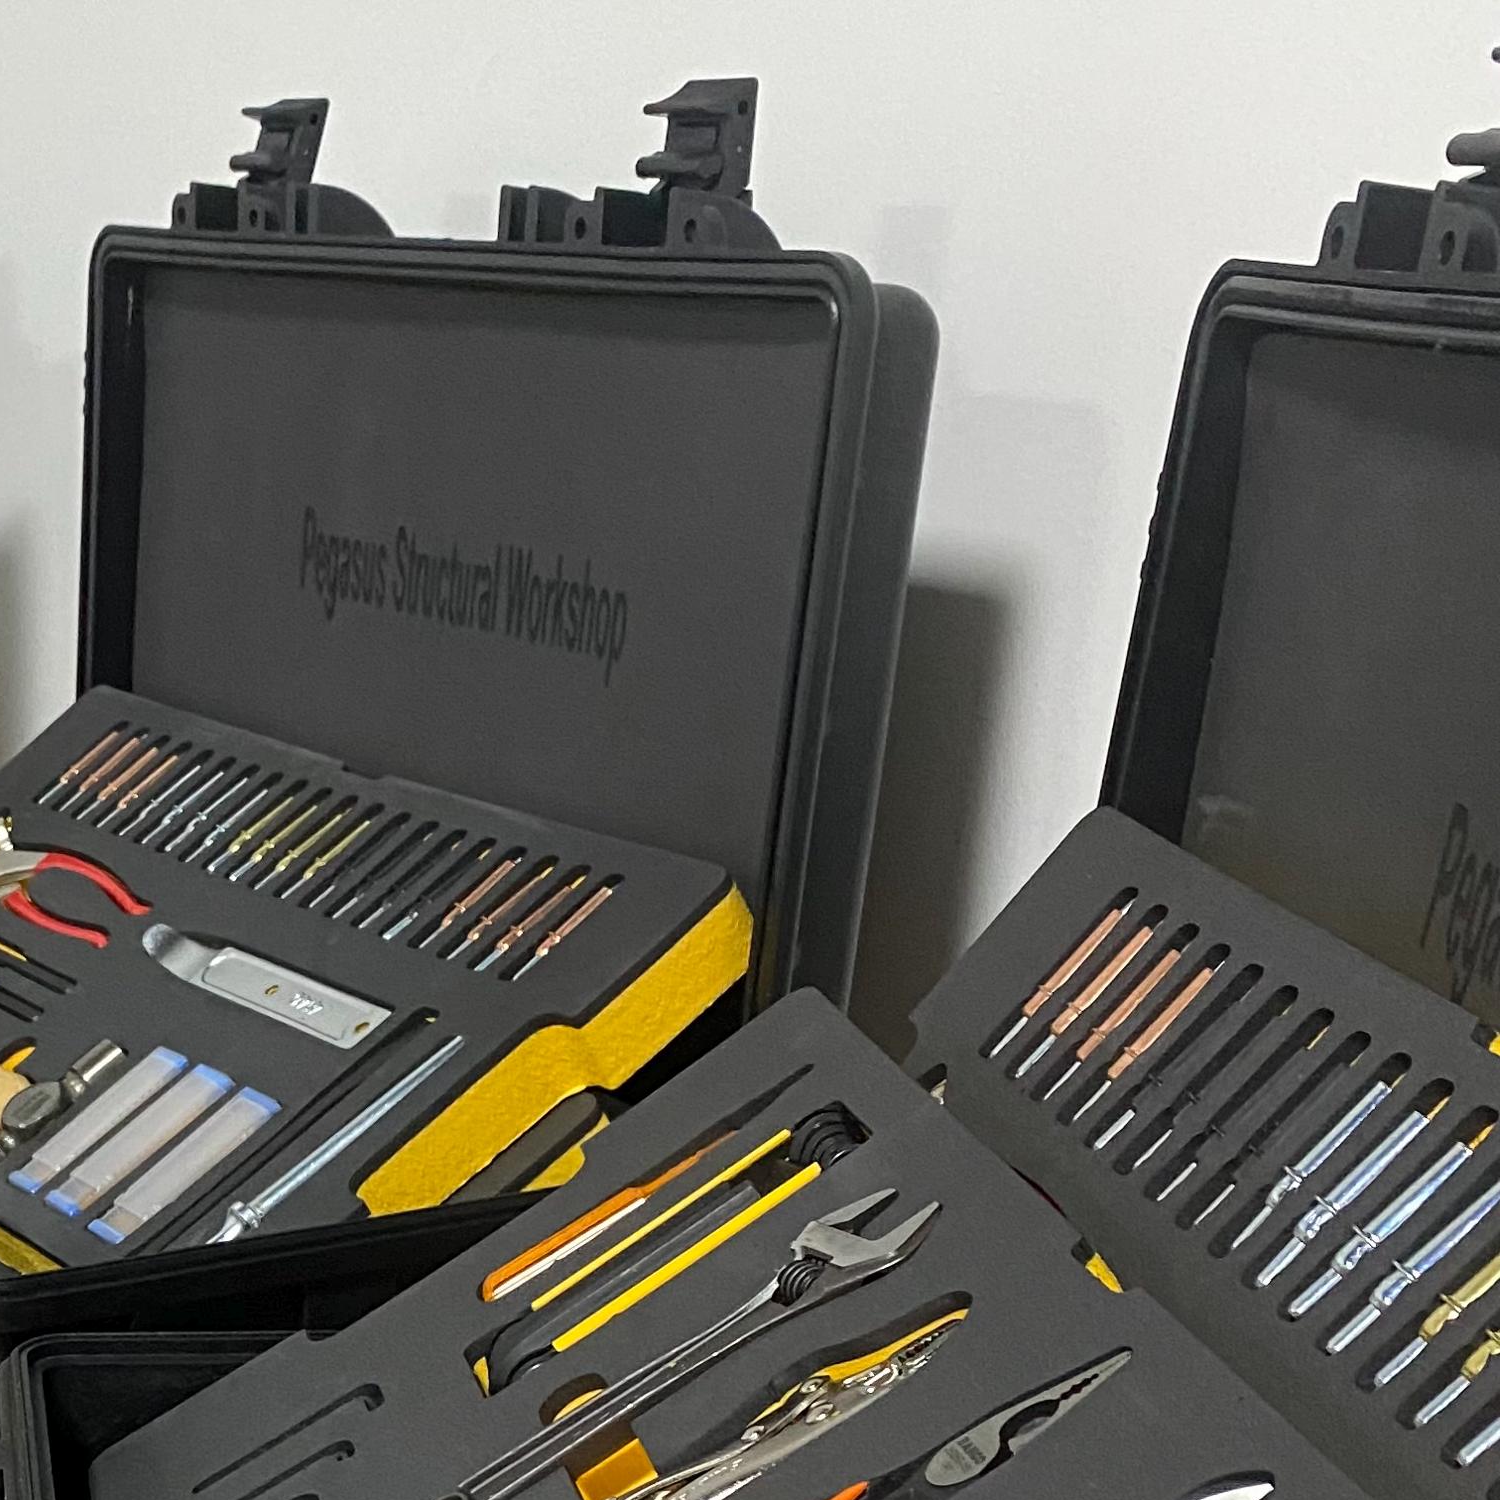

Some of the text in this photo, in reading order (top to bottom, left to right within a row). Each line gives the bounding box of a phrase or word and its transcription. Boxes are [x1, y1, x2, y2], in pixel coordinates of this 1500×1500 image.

[301, 505, 627, 688] Pegasus Structural Workshop
